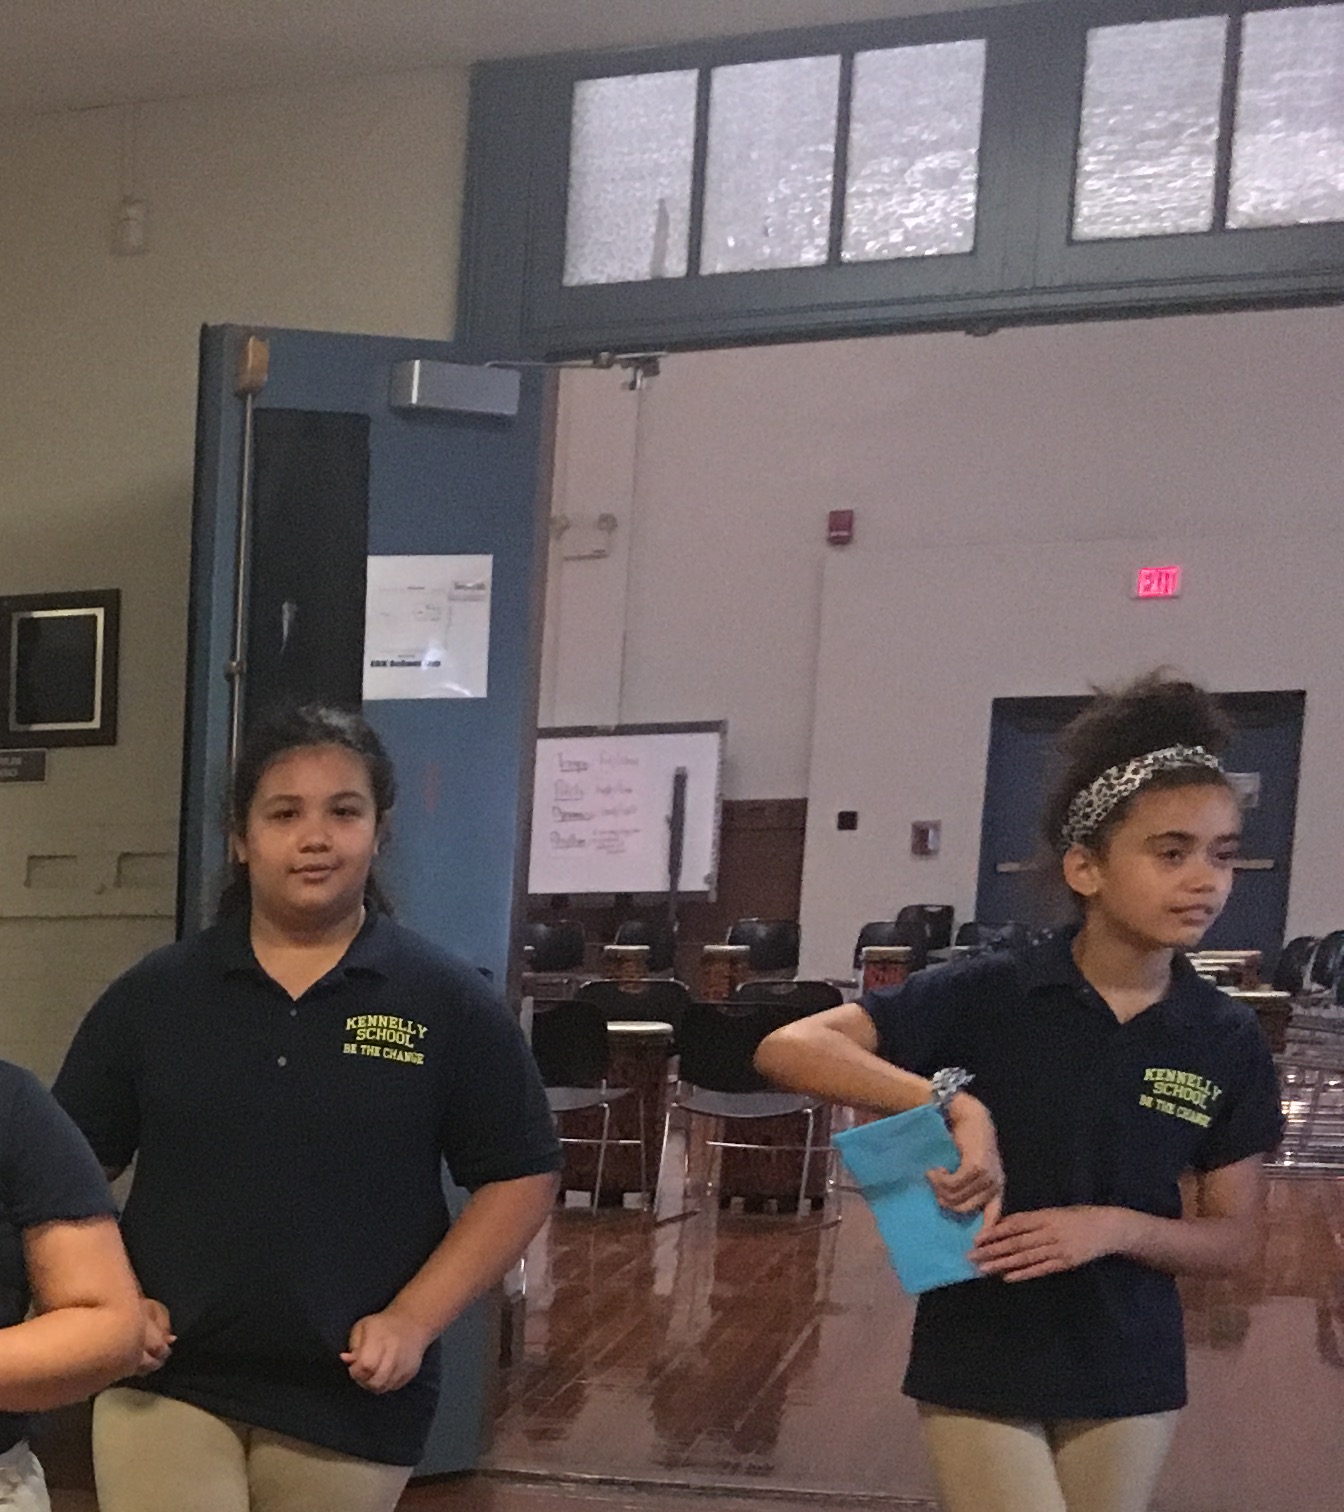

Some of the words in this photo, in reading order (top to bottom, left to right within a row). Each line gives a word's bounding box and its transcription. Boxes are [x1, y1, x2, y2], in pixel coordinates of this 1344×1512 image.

[345, 1014, 428, 1039] KENNELLY
[356, 1028, 414, 1048] SCHOOL
[343, 1043, 357, 1054] BE
[360, 1044, 381, 1057] THE
[382, 1047, 424, 1065] CHANGE
[1143, 1068, 1222, 1101] KENNELLY
[1152, 1081, 1207, 1110] SCHOOL
